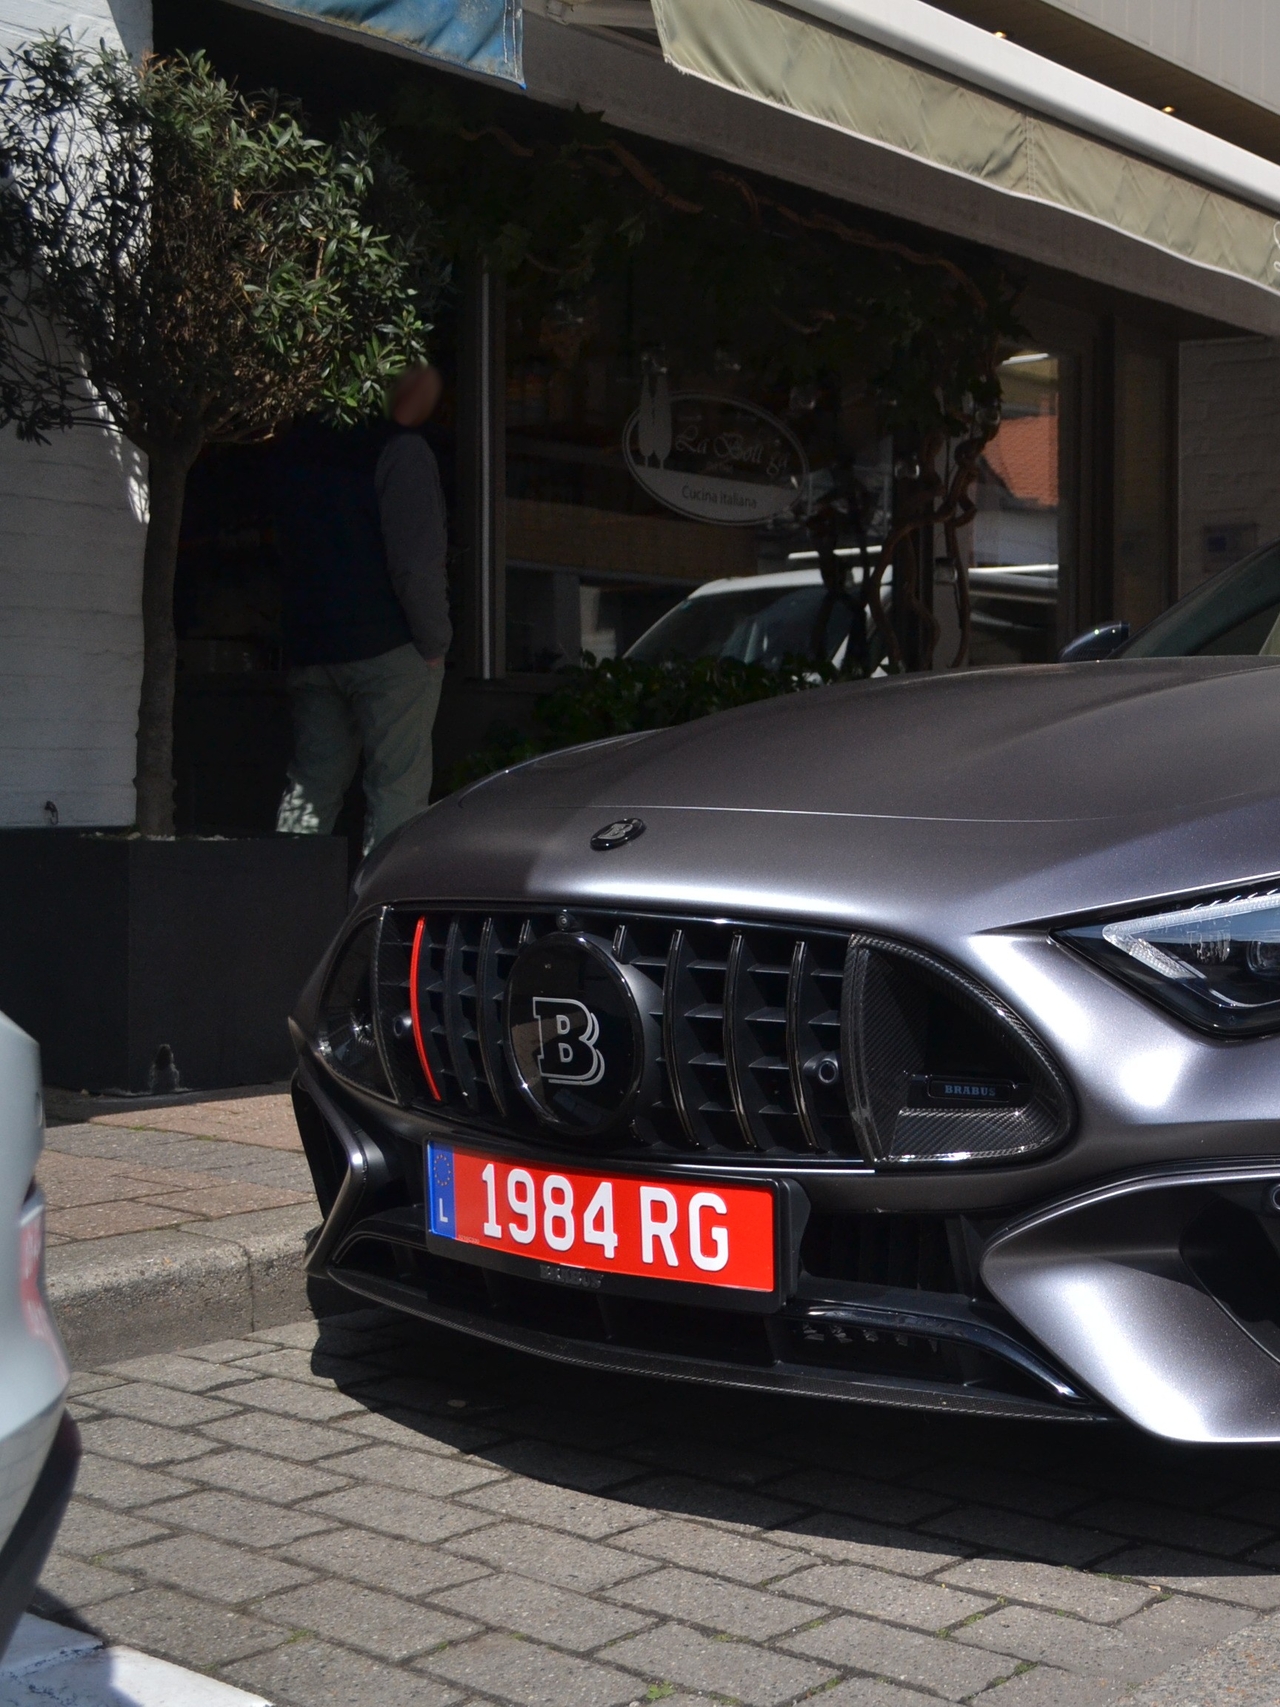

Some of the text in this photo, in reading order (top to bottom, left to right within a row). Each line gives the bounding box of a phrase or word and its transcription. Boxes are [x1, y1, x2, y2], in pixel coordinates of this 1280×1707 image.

[713, 431, 788, 476] Bottga
[681, 484, 718, 503] Cucina
[944, 1084, 996, 1097] BRABUS
[439, 1197, 448, 1223] L
[481, 1163, 729, 1272] 1984 RG
